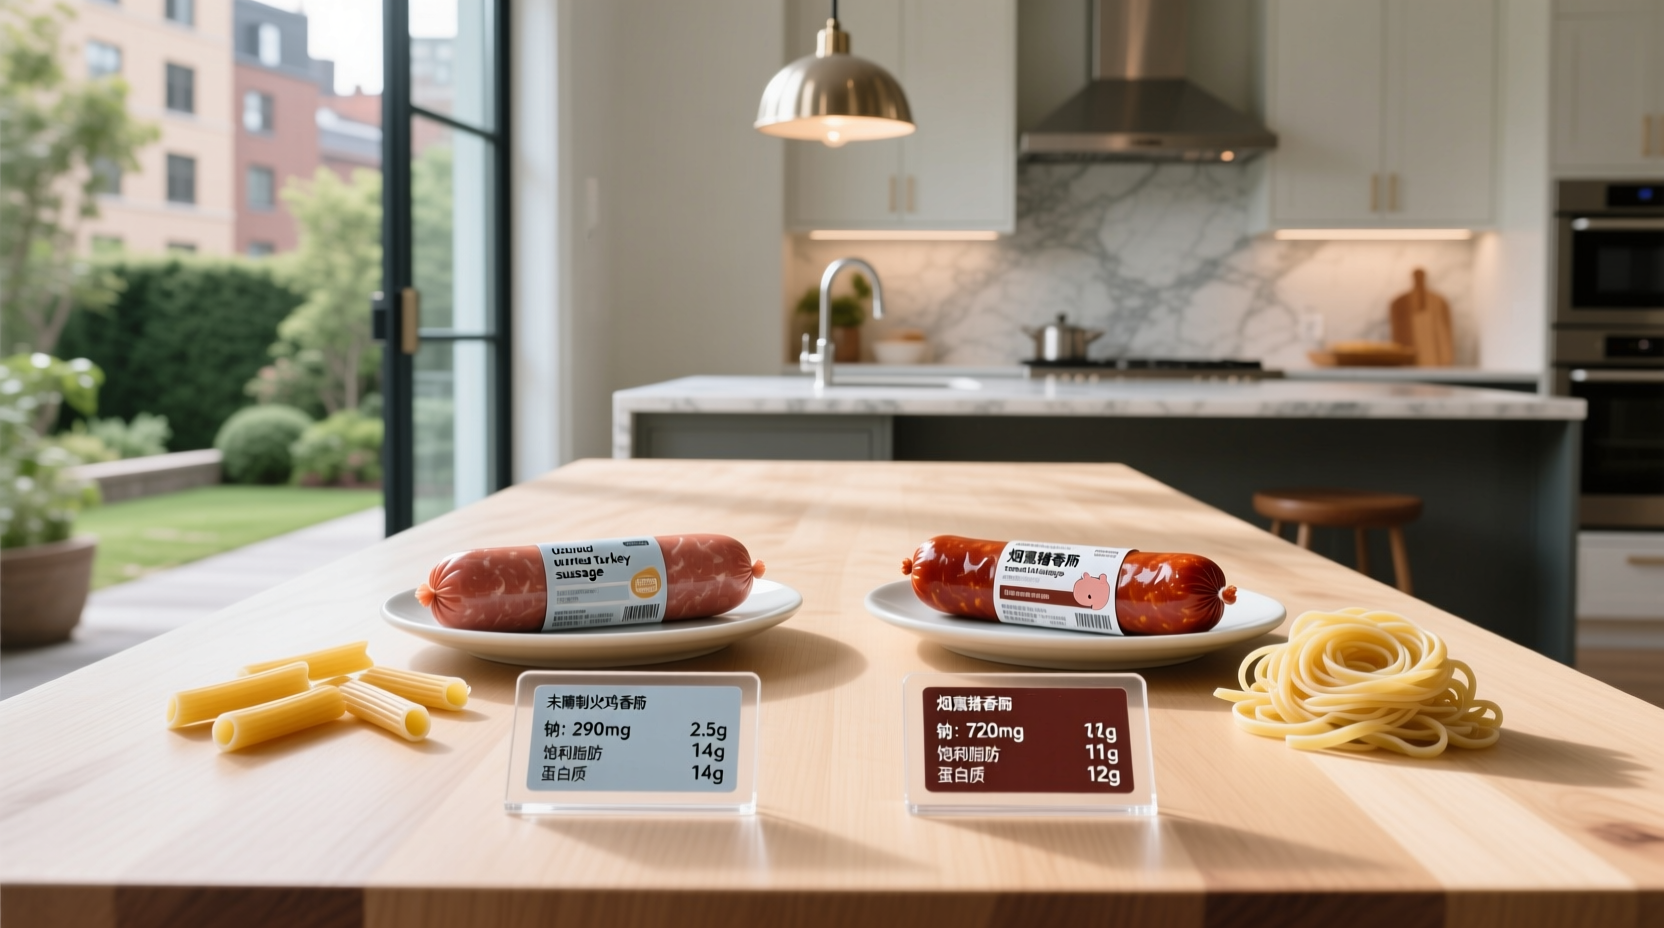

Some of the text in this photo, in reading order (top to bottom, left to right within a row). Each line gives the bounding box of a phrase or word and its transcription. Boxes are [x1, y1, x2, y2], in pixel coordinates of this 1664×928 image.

[572, 721, 631, 741] 290mg
[690, 722, 728, 741] 2.5g
[966, 722, 1024, 743] 720mg
[691, 743, 725, 762] 14g
[1085, 743, 1119, 764] 11g
[541, 765, 588, 782] 蛋白质
[691, 765, 724, 785] 14g
[937, 766, 985, 784] 蛋白质
[1087, 765, 1121, 787] 12g
